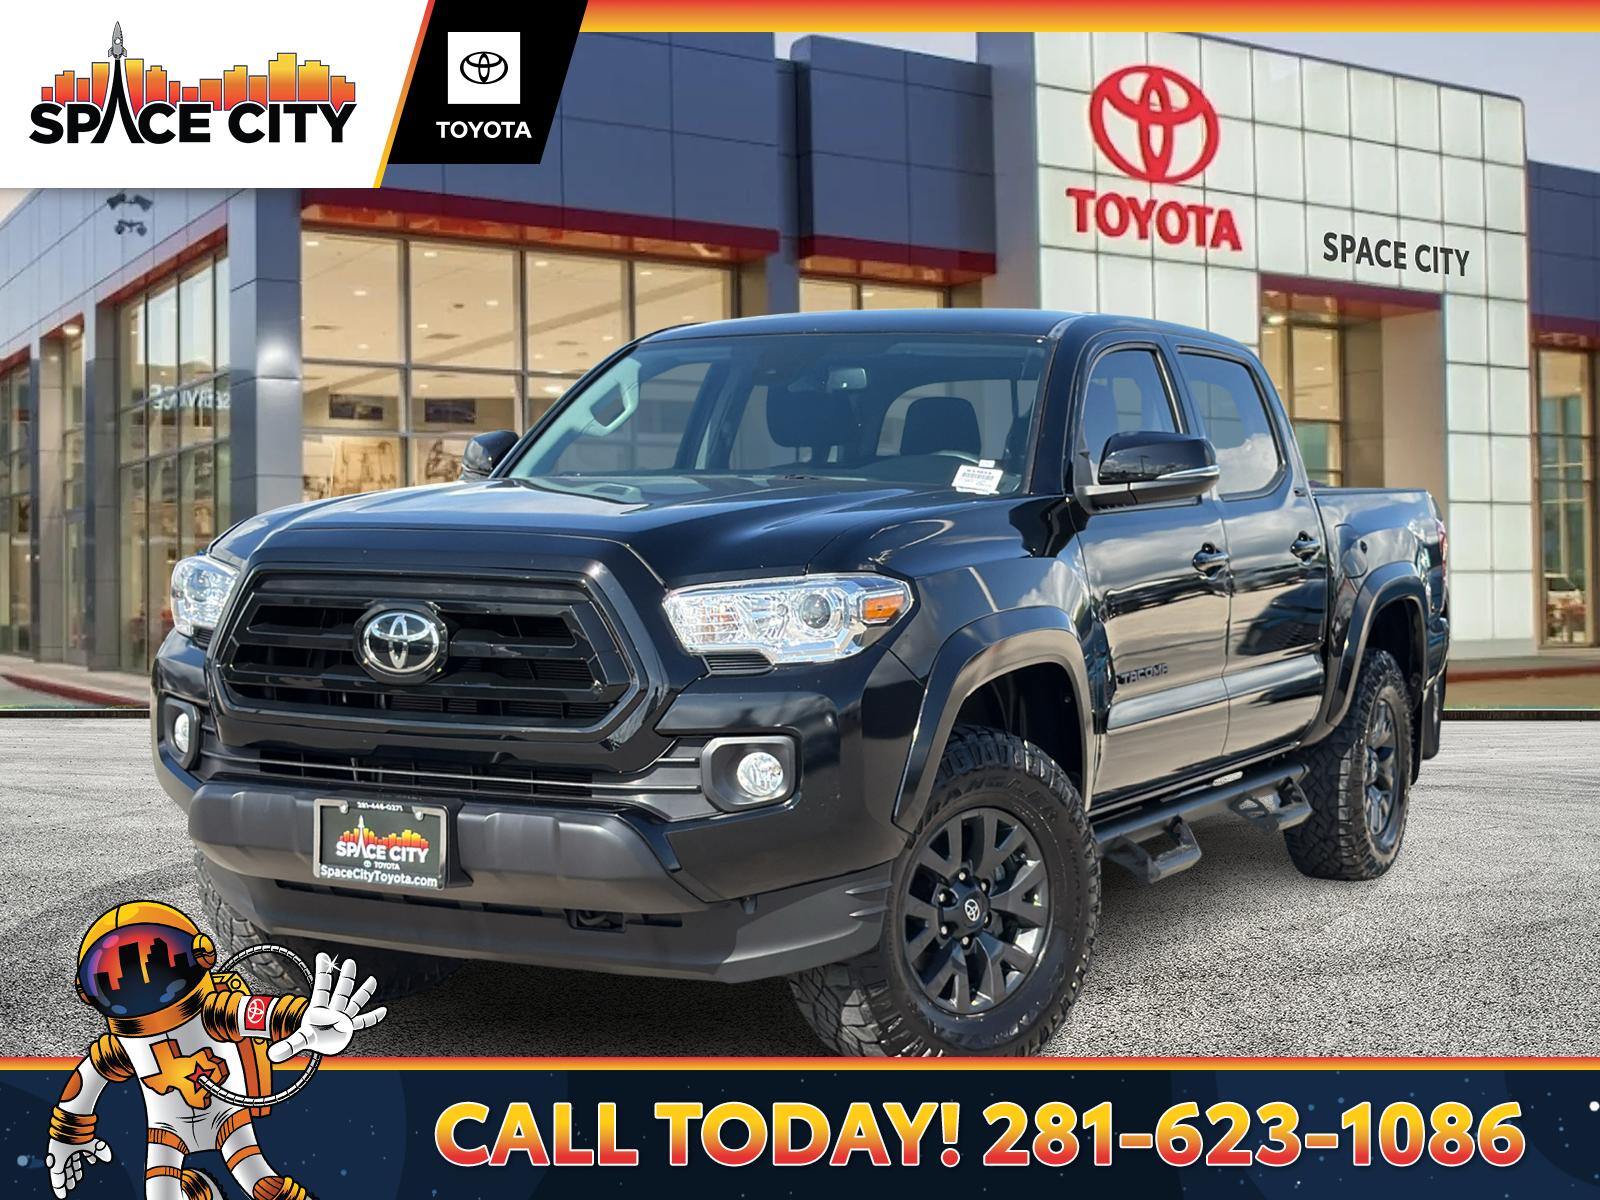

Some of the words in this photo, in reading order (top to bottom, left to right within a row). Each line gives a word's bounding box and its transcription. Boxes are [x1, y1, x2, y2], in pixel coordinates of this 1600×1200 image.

[1066, 188, 1242, 251] TOYOTA
[1322, 231, 1408, 270] SPACE
[1414, 245, 1471, 277] CITY
[1117, 663, 1168, 684] TACOMA
[336, 840, 387, 860] SPACE
[390, 846, 429, 864] CITY
[320, 864, 438, 888] SpaceCityToyota.com
[374, 860, 400, 871] TOYOTA
